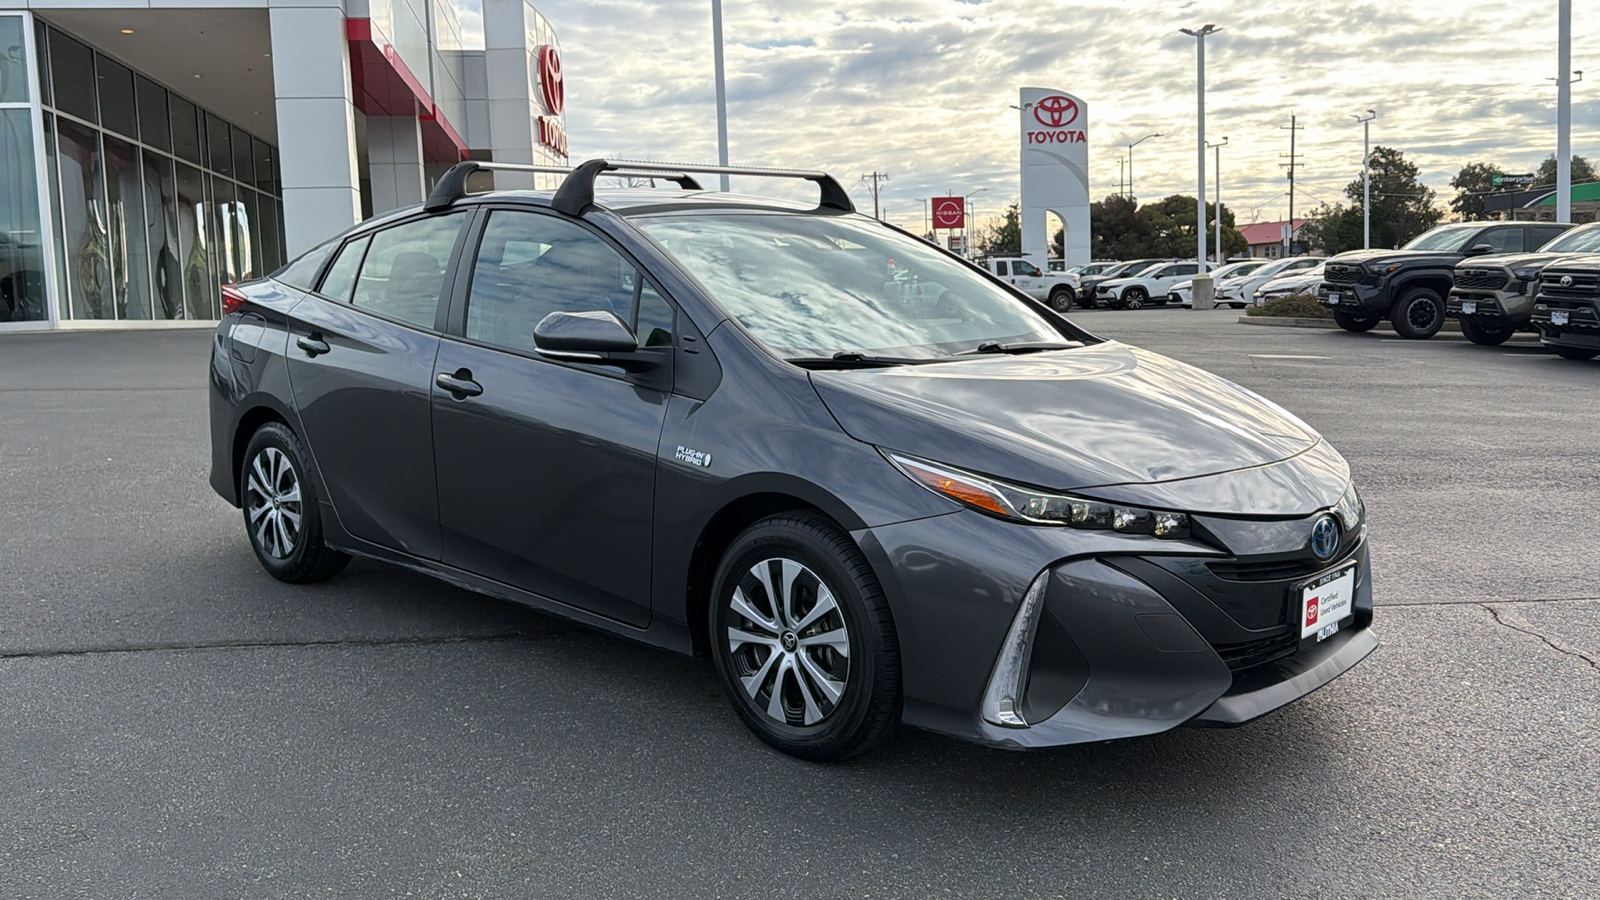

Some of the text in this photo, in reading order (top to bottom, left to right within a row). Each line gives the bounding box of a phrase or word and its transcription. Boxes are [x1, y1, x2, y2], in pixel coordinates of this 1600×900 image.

[538, 116, 568, 158] TOYOT
[1027, 131, 1086, 144] TOYOTA
[1494, 176, 1534, 184] enterprise
[675, 452, 702, 466] HYBRID
[677, 445, 704, 460] PLUG-IN
[1321, 591, 1339, 605] Certified
[1321, 599, 1348, 616] Used Vehicles
